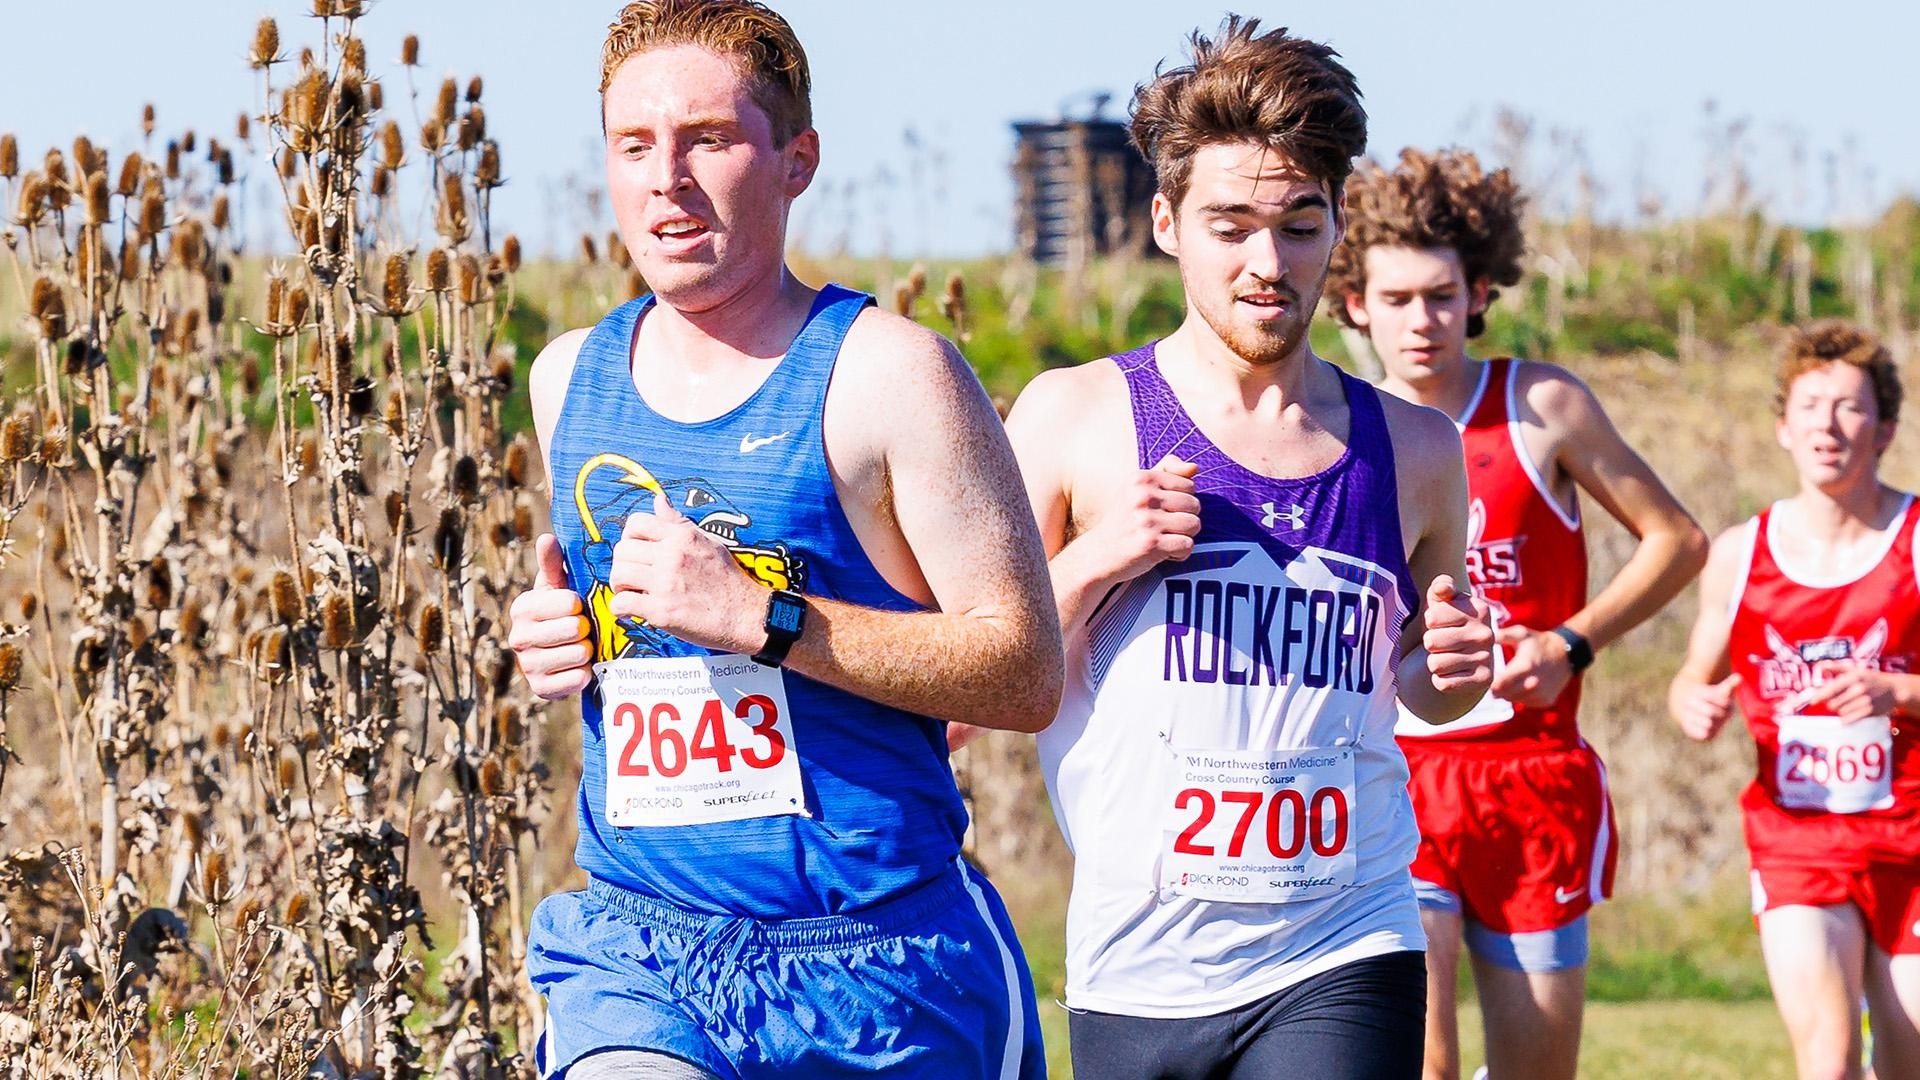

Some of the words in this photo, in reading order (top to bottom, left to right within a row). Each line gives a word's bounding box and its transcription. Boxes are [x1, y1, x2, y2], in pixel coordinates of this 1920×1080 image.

[1164, 579, 1380, 695] ROCKFORD
[629, 668, 701, 681] Northwestern
[617, 685, 641, 696] Cross
[642, 685, 675, 697] Country
[676, 684, 713, 696] Course
[613, 695, 785, 777] 2643
[1203, 757, 1288, 771] Northwestern
[1289, 756, 1336, 769] Medicine
[655, 778, 741, 793] www.chicagotrack.org
[1185, 773, 1215, 784] Cross
[1217, 773, 1260, 786] Country
[1261, 775, 1296, 785] Course
[632, 798, 653, 809] DICK
[654, 797, 683, 809] POND
[1174, 787, 1348, 859] 2700
[1218, 864, 1306, 874] www.chicagotrack.org
[1189, 873, 1214, 885] DICK
[1216, 875, 1250, 887] POND
